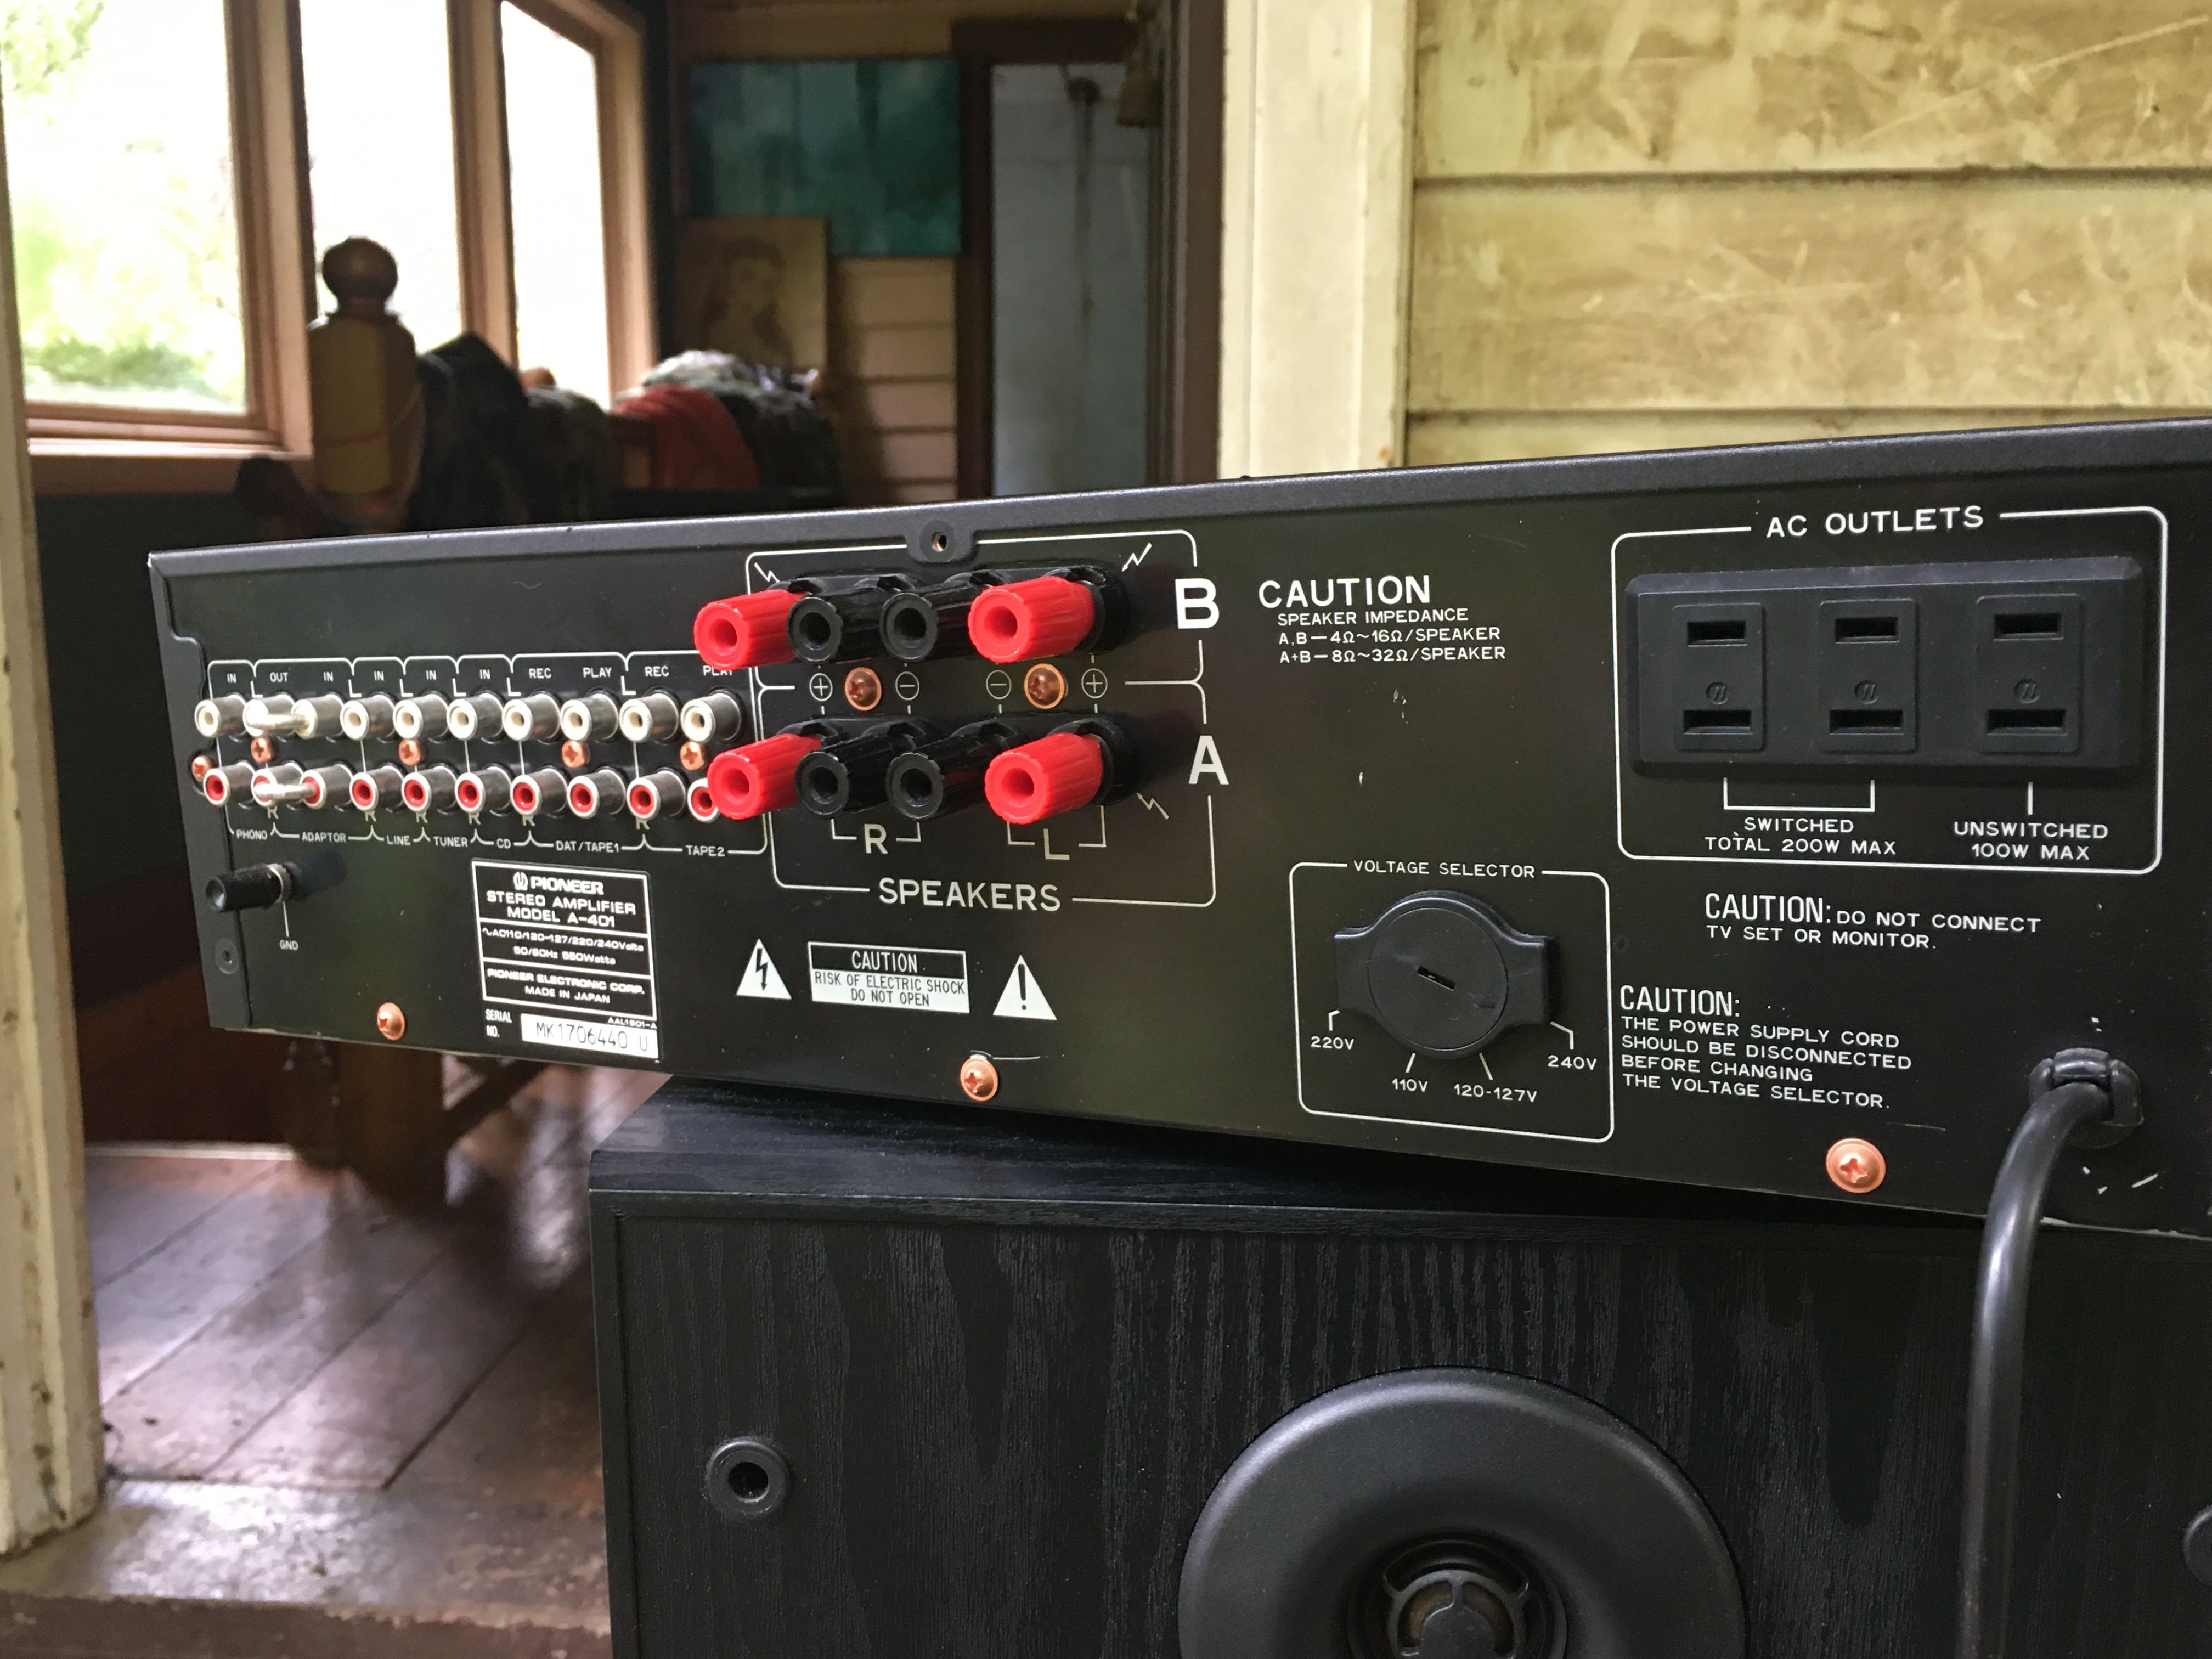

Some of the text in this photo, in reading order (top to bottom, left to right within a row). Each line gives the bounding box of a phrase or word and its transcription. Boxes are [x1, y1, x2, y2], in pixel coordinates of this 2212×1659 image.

[1767, 506, 1983, 538] AC OUTLETS
[1259, 575, 1430, 608] CAUTION
[1175, 578, 1219, 629] B
[1277, 607, 1469, 627] SPEAKER IMPEDANCE
[227, 673, 236, 684] IN
[269, 672, 289, 683] OUT
[323, 671, 334, 682] IN
[374, 670, 384, 681] IN
[426, 669, 437, 680] IN
[479, 668, 490, 680] IN
[528, 668, 552, 679] REC
[583, 667, 612, 678] PLAY
[645, 665, 669, 678] REC
[1188, 735, 1229, 785] A
[1743, 816, 1854, 833] SWITCHED
[1954, 821, 2108, 839] UNSWITCHED
[236, 830, 268, 840] PHONO
[302, 831, 347, 843] ADAPTOR
[386, 834, 411, 846] LINE
[433, 836, 469, 848] TUNER
[496, 838, 511, 849] CD
[865, 823, 889, 855] R
[1043, 828, 1070, 860] L
[686, 844, 726, 857] TAPE2
[1705, 837, 1897, 855] TOTAL 200W MAX
[1971, 843, 2090, 861] 100W MAX
[1353, 860, 1535, 879] VOLTAGE SELECTOR
[530, 876, 604, 895] PIONEER
[878, 878, 1061, 911] SPEAKERS
[487, 890, 636, 916] STEREO AMPLIFIER
[1705, 892, 2041, 933] CAUTION: DO NOT CONNECT
[507, 906, 616, 928] MODEL A-401
[279, 940, 299, 951] GND
[1706, 924, 1937, 950] TV SET OR MONITOR.
[851, 950, 918, 973] CAUTION
[487, 968, 645, 995] PIONEER ELECTRONIC CORP.
[815, 971, 966, 995] RISK OF ELECTRIC SHOCK
[524, 985, 611, 1004] MADE IN JAPAN
[851, 988, 930, 1007] DO NOT OPEN
[1620, 984, 1740, 1017] CAUTION:
[485, 1008, 513, 1024] SERIAL
[486, 1024, 500, 1038] NO.
[536, 1021, 628, 1049] MK1706440
[1621, 1015, 1900, 1048] THE POWER SUPPLY CORD
[1310, 1036, 1355, 1051] 220V
[1621, 1035, 1912, 1070] SHOULD BE DISCONNECTED
[1547, 1054, 1597, 1071] 240V
[1621, 1054, 1813, 1082] BEFORE CHANGING
[1391, 1078, 1428, 1093] 110V
[1453, 1084, 1537, 1103] 120-127V
[1622, 1073, 1891, 1109] THE VOLTAGE SELECTOR.
